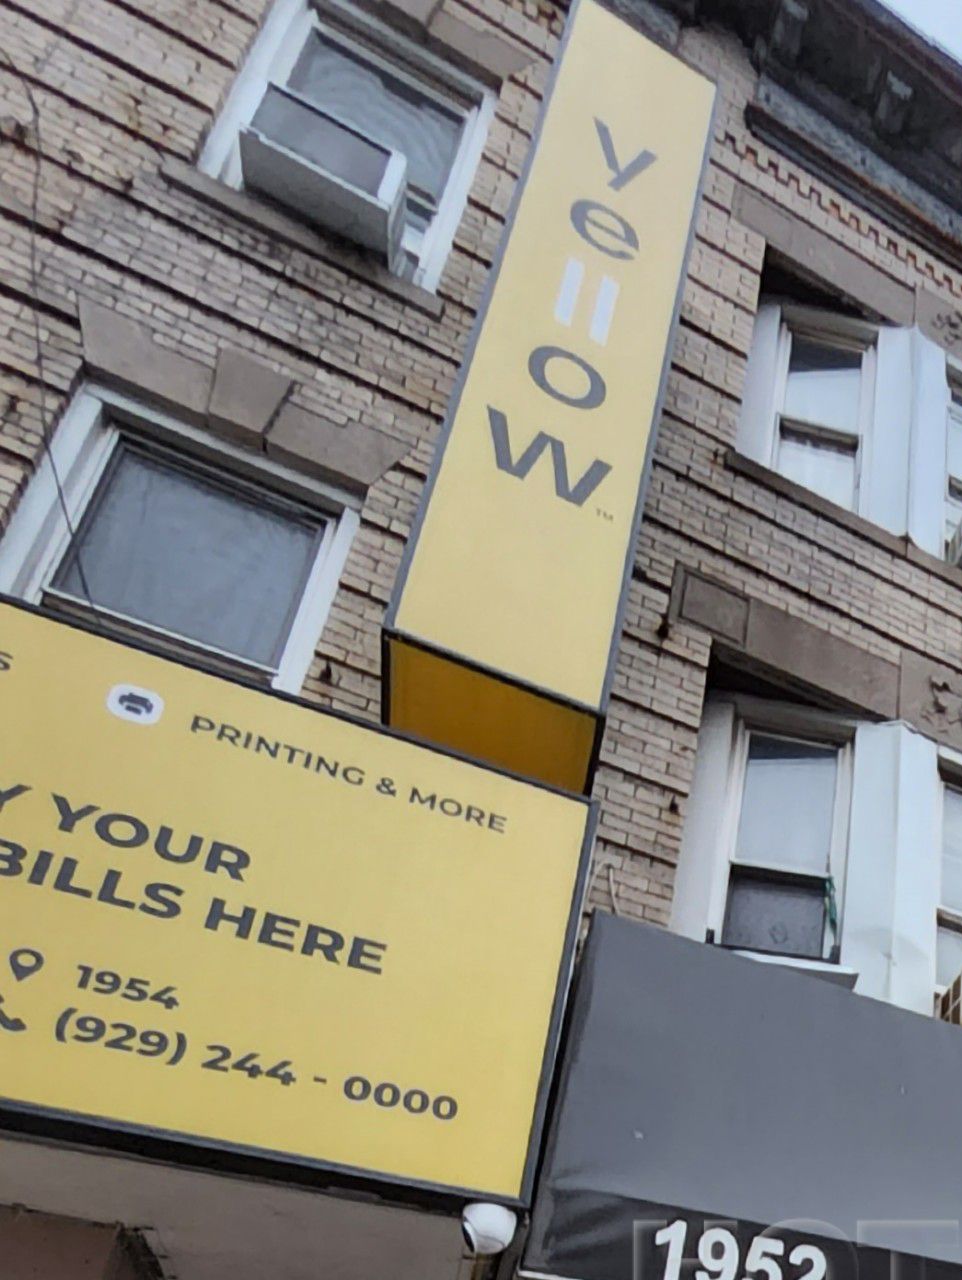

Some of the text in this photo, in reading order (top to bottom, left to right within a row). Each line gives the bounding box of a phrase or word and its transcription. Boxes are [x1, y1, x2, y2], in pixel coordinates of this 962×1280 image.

[190, 713, 508, 834] PRINTING & MORE
[51, 792, 252, 882] YOUR
[0, 838, 388, 976] BILLS HERE
[76, 964, 181, 1010] 1954
[54, 1007, 188, 1067] (929)
[201, 1044, 297, 1086] 244
[343, 1075, 459, 1122] 0000
